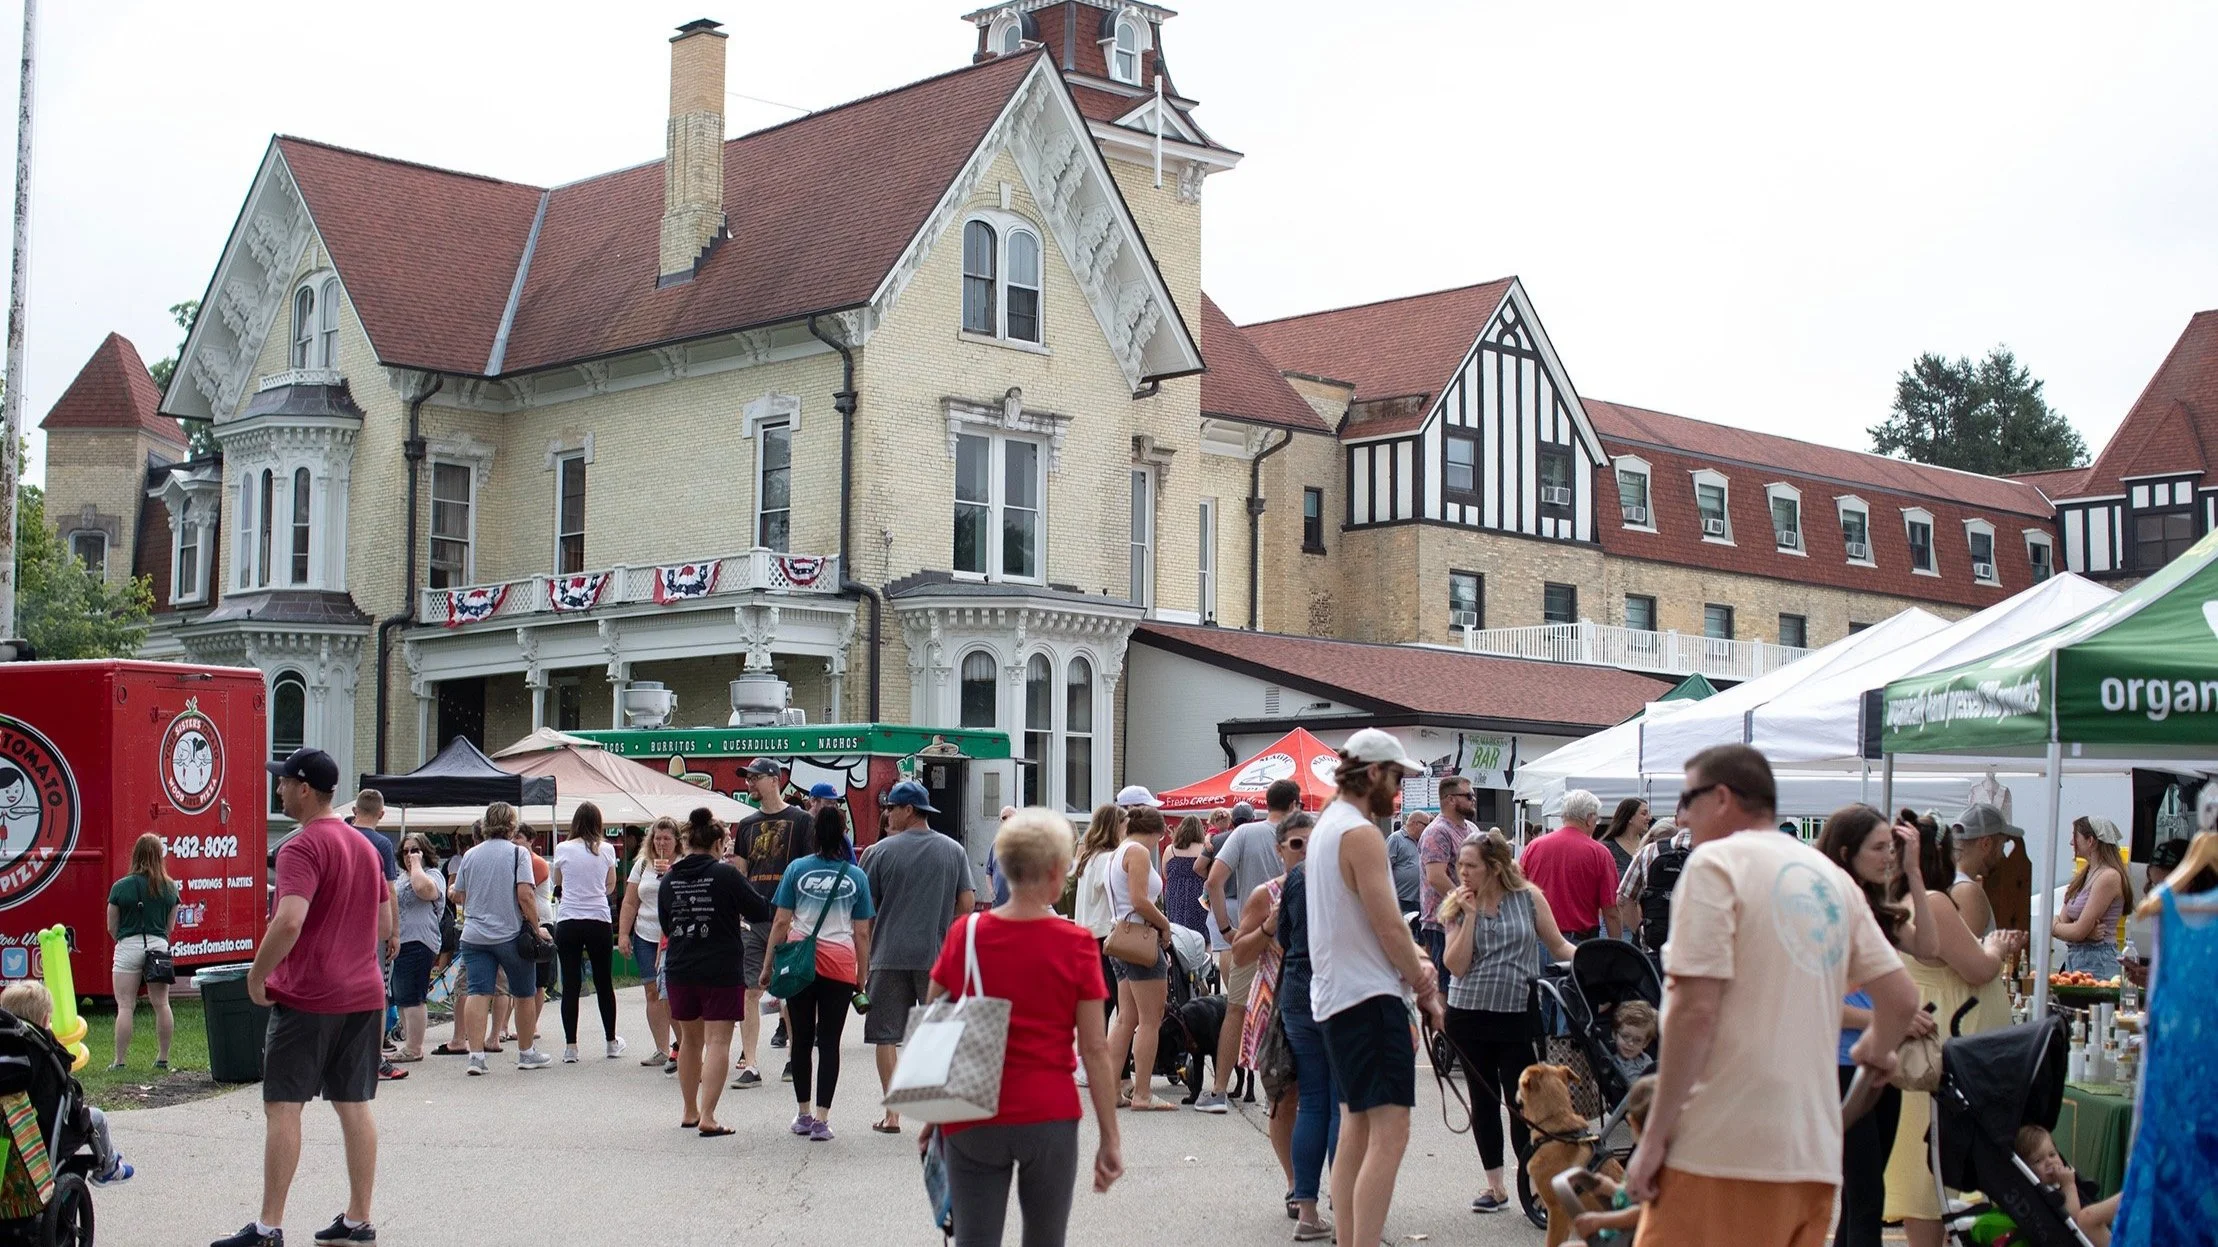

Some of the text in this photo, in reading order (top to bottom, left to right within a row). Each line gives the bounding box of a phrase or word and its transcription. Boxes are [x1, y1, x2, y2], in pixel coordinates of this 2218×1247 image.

[650, 741, 696, 753] BURRITOS
[722, 738, 790, 751] QUESADILLAS
[818, 737, 858, 750] NACHOS
[1259, 752, 1293, 765] MAGIC
[1470, 746, 1501, 770] BAR
[3, 732, 63, 808] TOMATO
[200, 778, 218, 805] PIZZA
[1166, 796, 1190, 808] Fresh
[1190, 795, 1226, 806] CREPES
[0, 846, 54, 893] PIZZA
[187, 878, 223, 891] WEDDINGS
[227, 876, 254, 889] PARTIES
